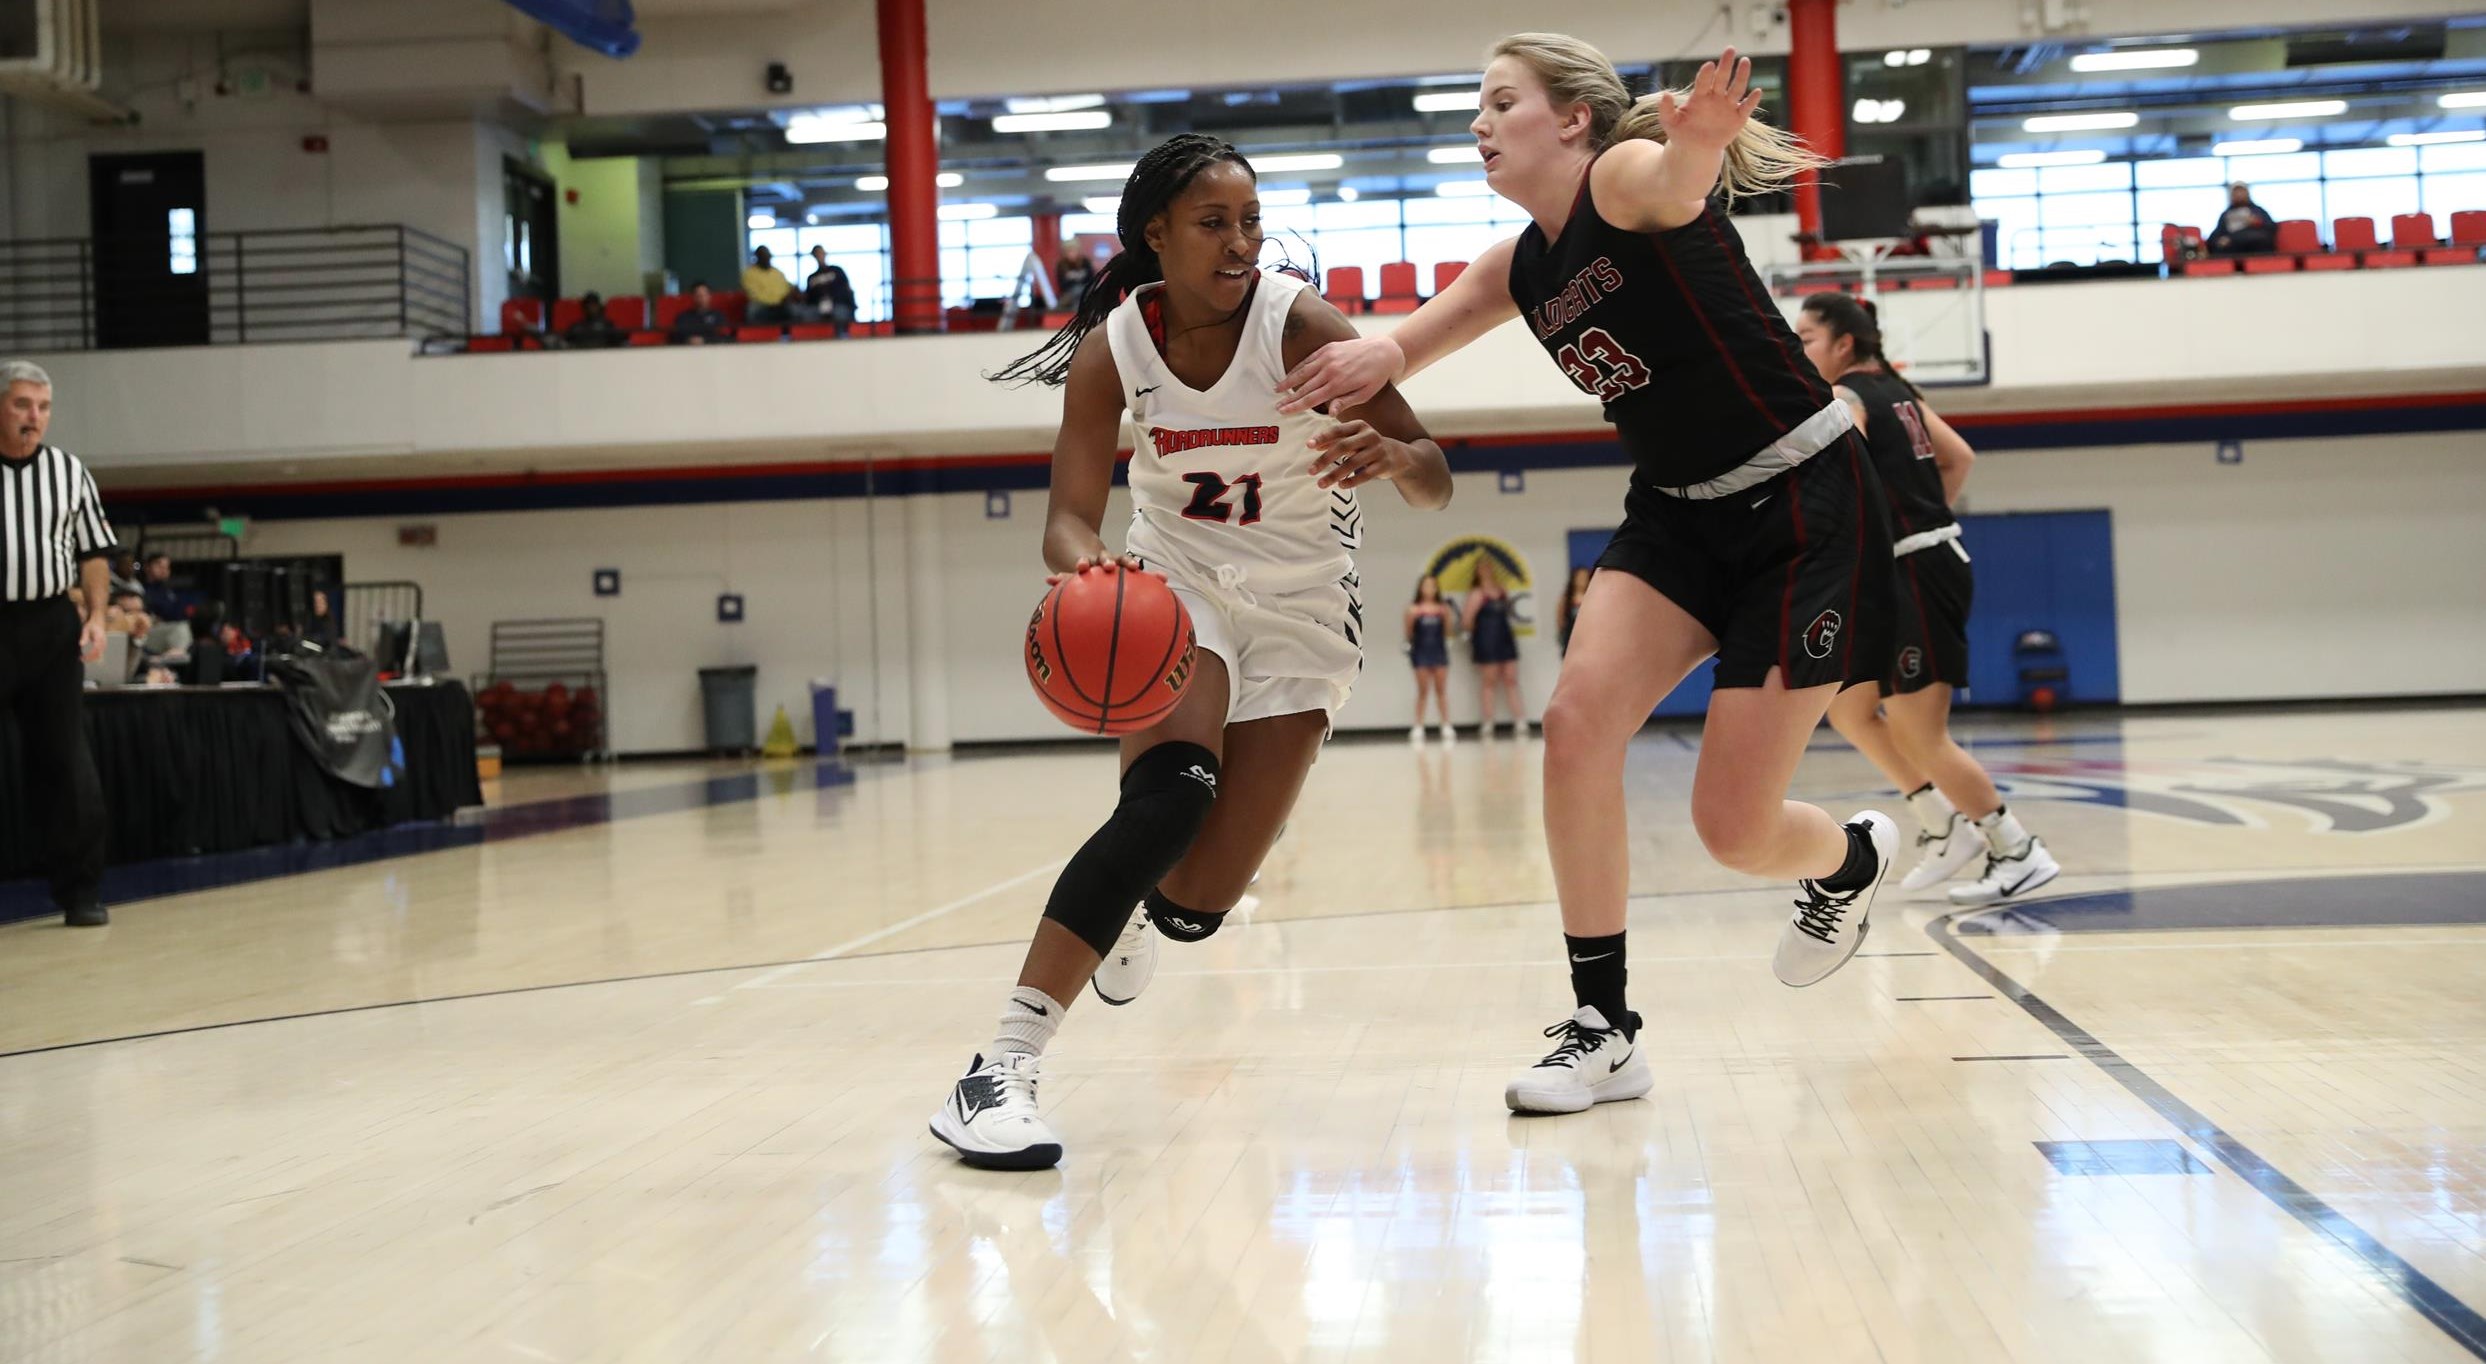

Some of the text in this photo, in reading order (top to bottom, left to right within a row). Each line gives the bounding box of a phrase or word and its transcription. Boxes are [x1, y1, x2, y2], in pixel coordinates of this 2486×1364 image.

[1557, 326, 1652, 403] 23
[1148, 426, 1280, 460] ROADRUNNERS
[1181, 471, 1263, 526] 21
